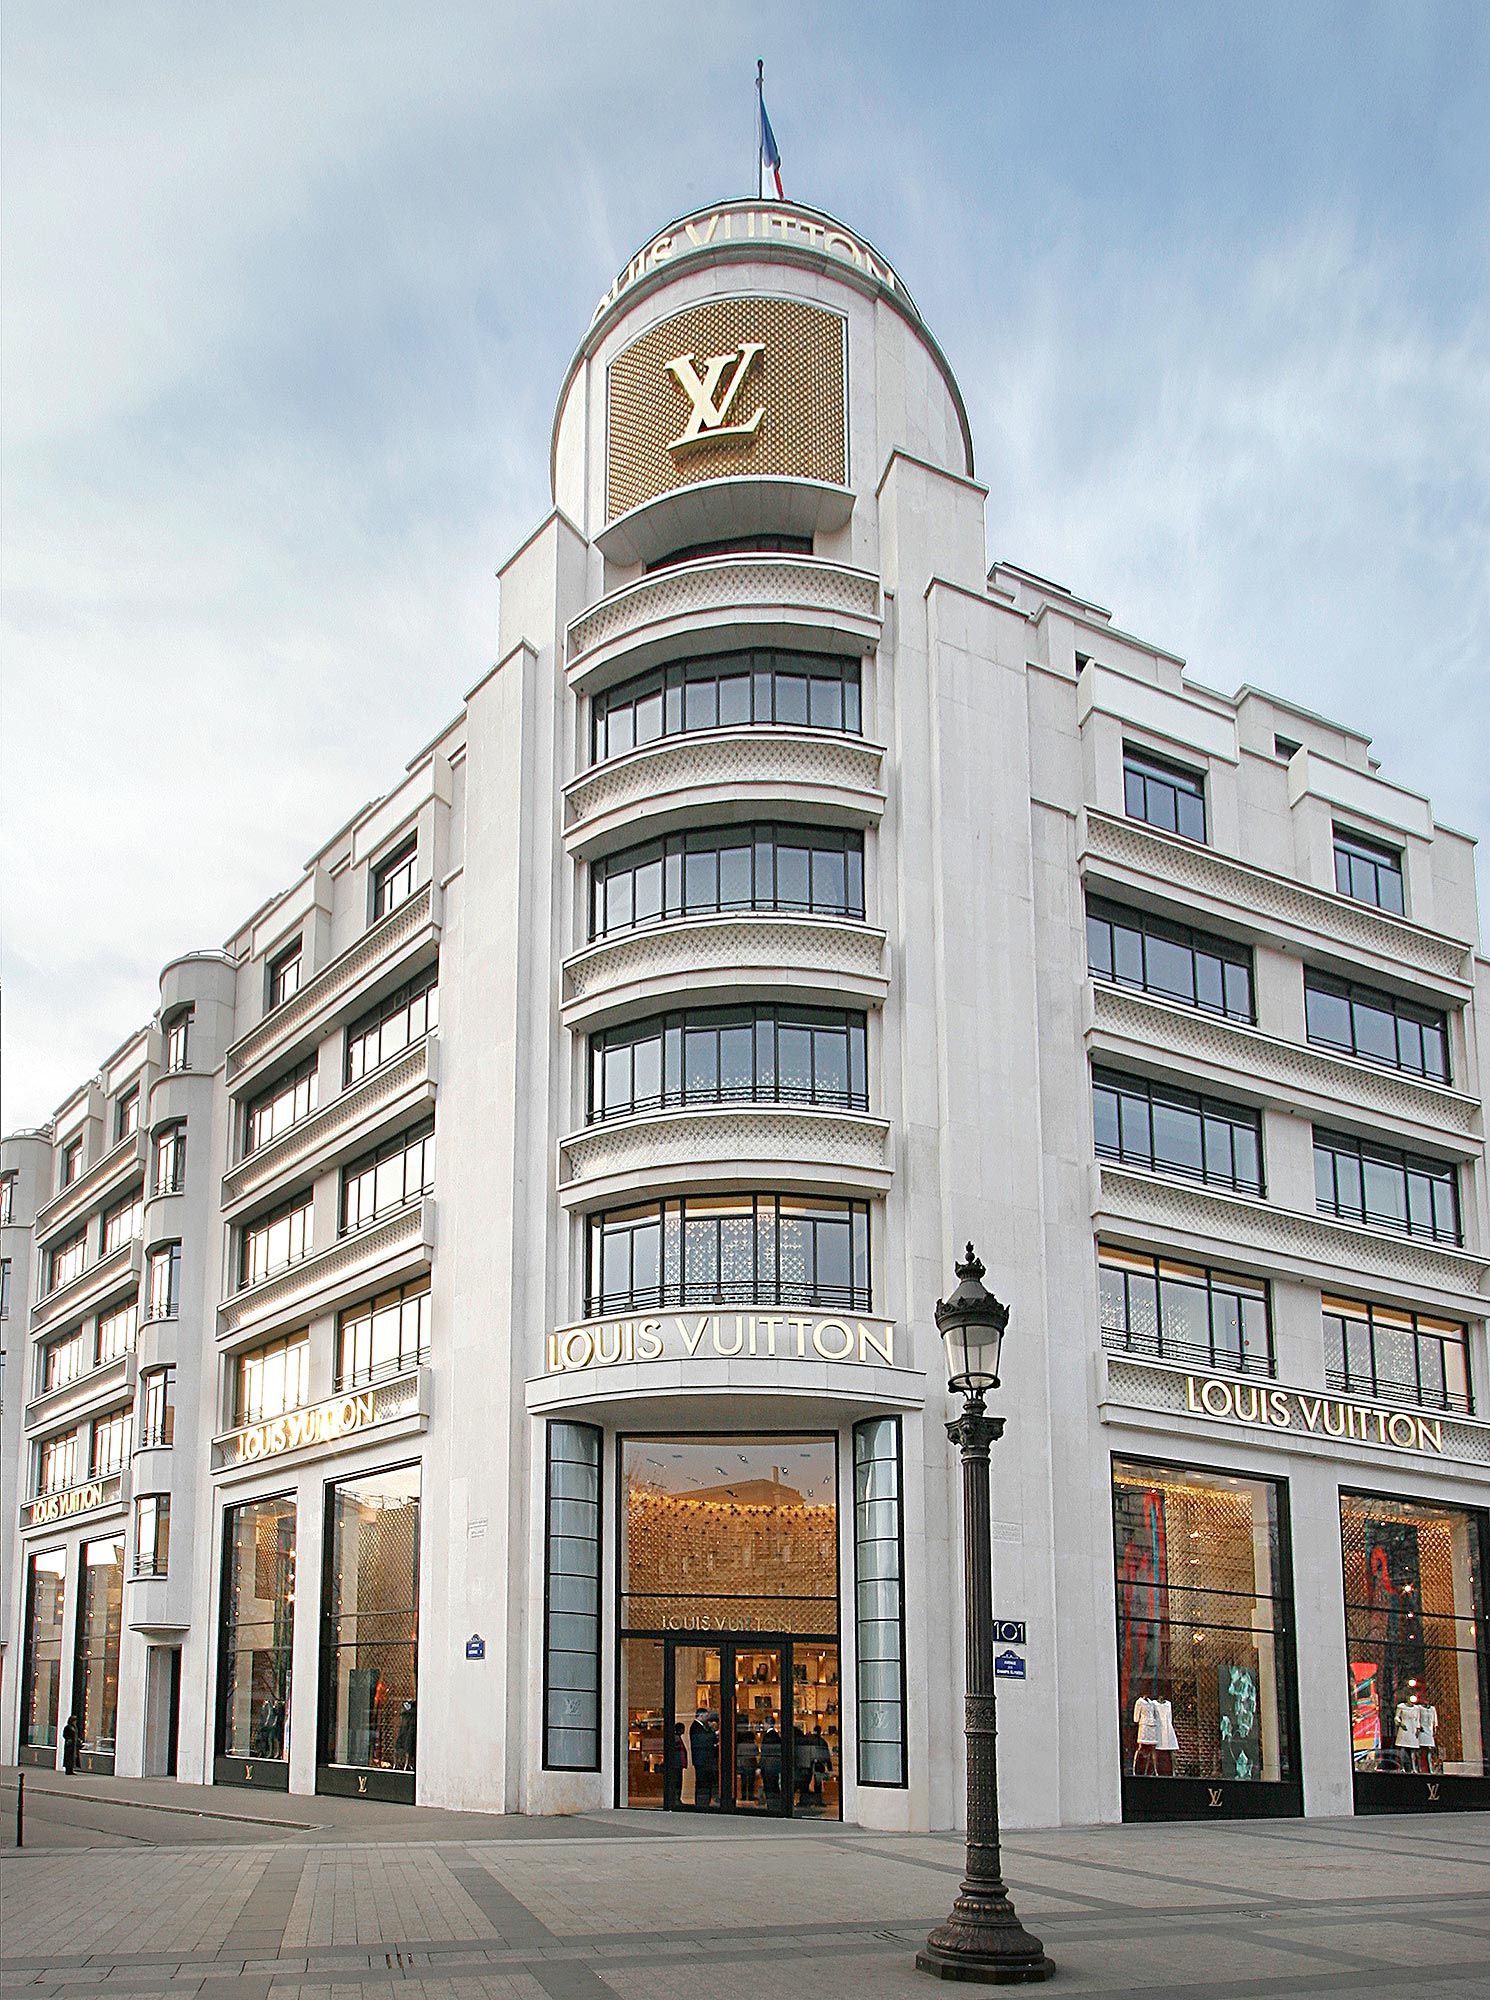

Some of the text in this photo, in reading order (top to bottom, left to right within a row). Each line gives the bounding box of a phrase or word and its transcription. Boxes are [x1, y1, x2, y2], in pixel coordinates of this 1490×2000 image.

[664, 343, 766, 450] LV
[548, 1316, 894, 1372] LOUIS VUITTON
[1187, 1376, 1442, 1453] LOUIS VUITTON
[237, 1418, 288, 1461] LOUIS
[32, 1496, 59, 1524] LOUIS
[662, 1615, 793, 1633] LOUIS VUITTON
[993, 1621, 1024, 1642] 101
